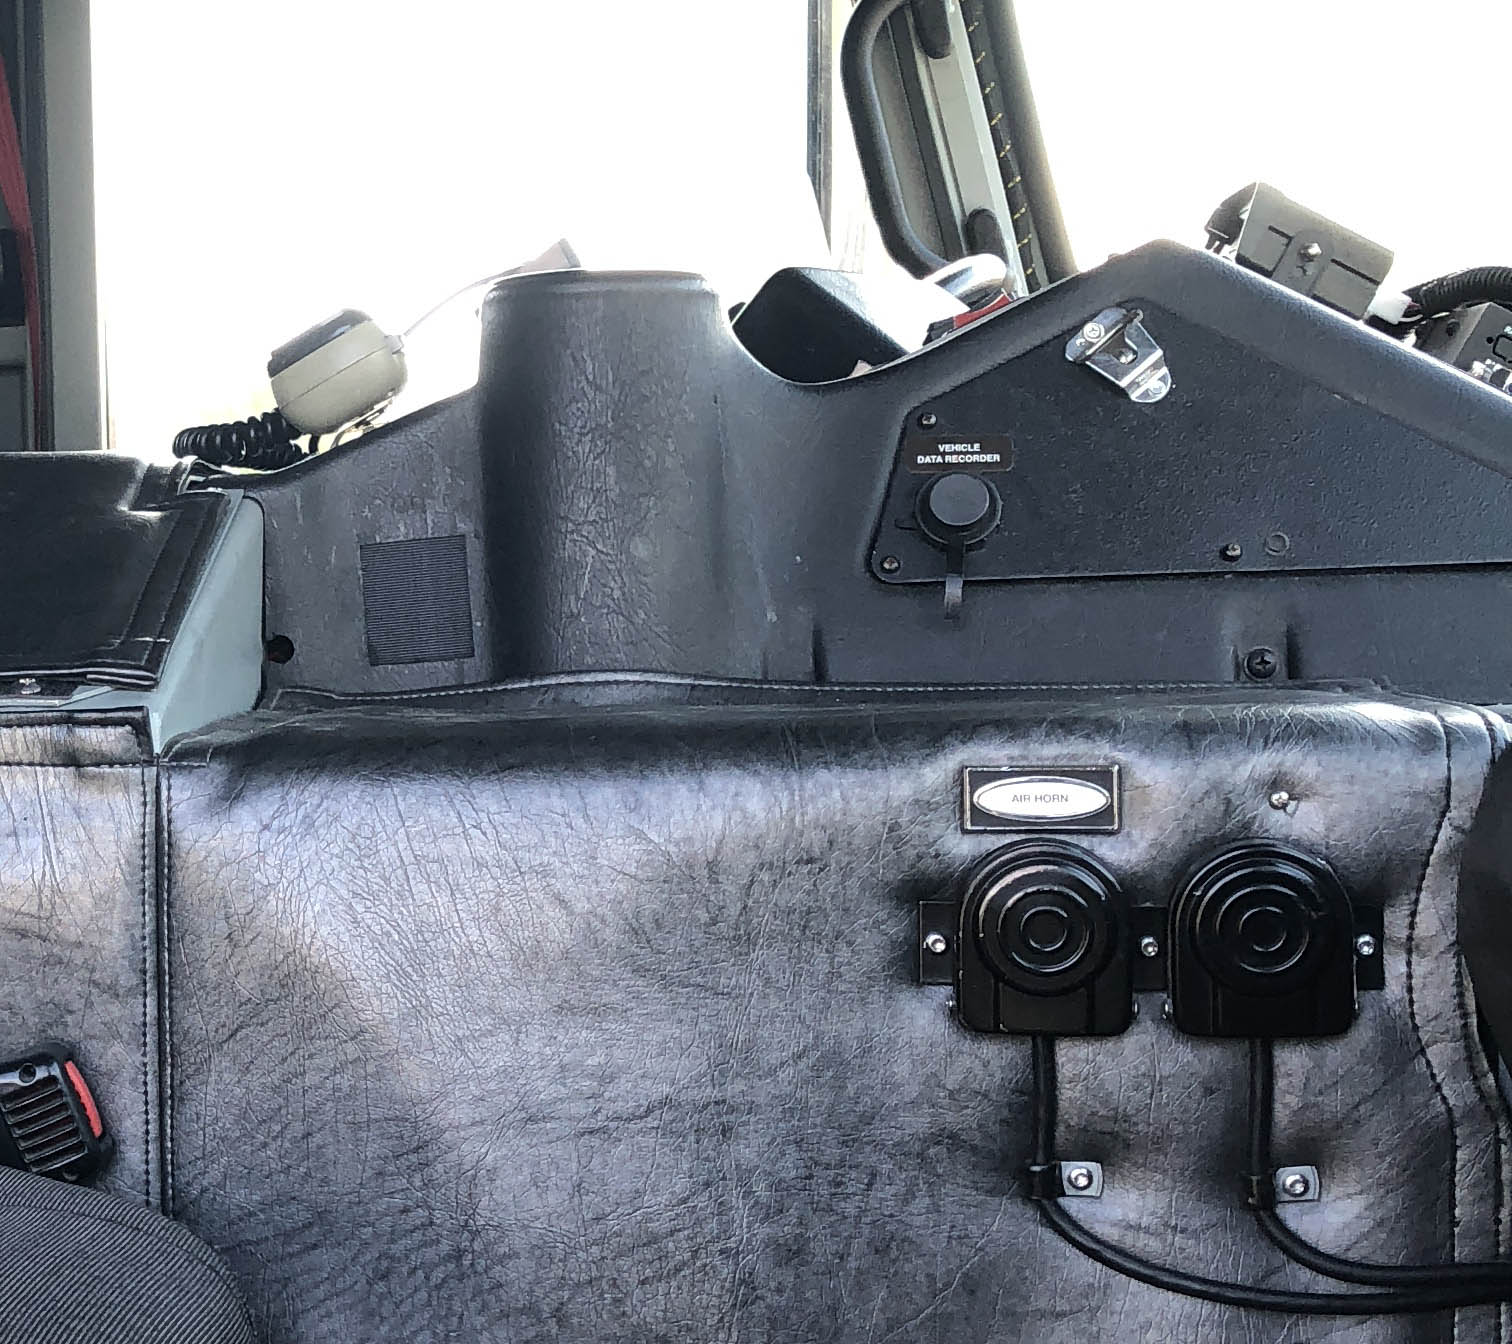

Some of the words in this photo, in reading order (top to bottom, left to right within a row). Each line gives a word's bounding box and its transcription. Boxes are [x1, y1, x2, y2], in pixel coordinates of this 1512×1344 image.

[938, 443, 981, 452] VEHICLE
[917, 455, 943, 464] DATA
[945, 454, 1001, 464] RECORDER
[1011, 794, 1031, 803] AIR
[1034, 794, 1069, 803] HORN
